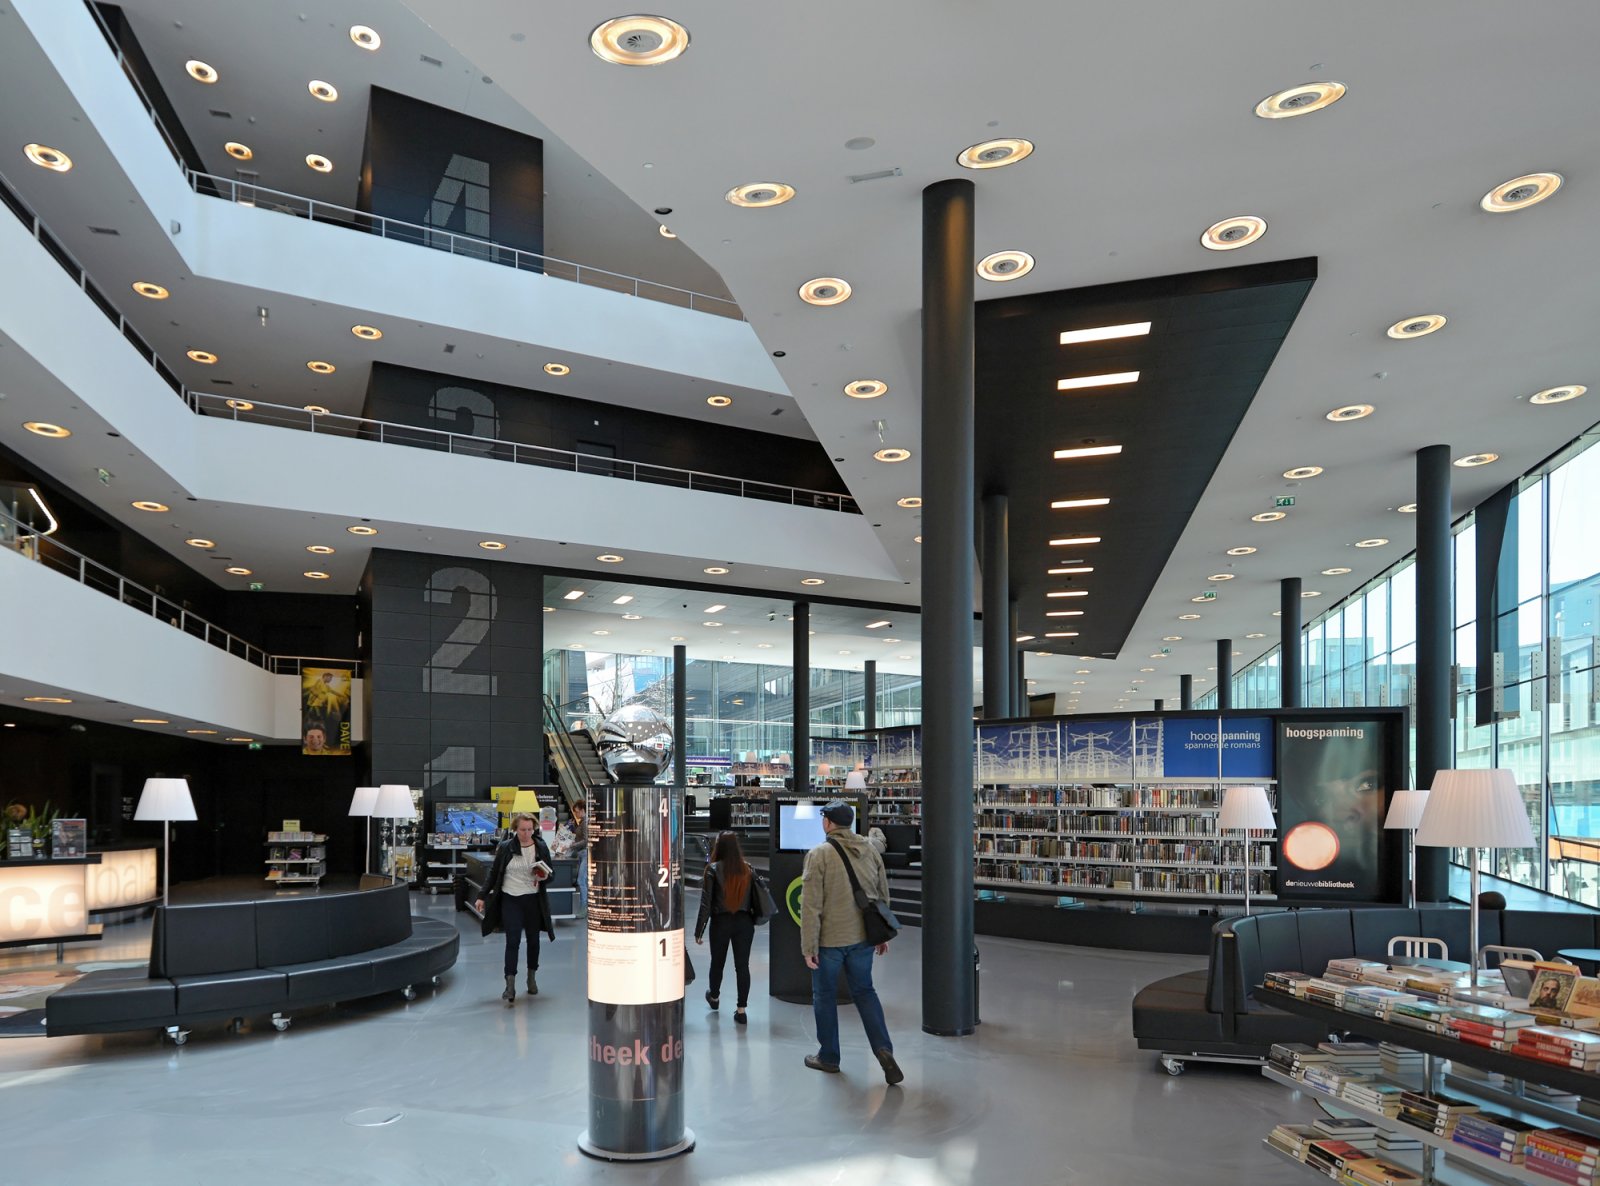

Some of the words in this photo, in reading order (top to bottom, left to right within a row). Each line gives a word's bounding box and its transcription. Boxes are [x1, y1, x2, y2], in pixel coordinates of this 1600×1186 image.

[423, 154, 500, 262] 4
[423, 567, 498, 696] 2
[340, 722, 351, 750] DAVE
[1190, 730, 1261, 743] hoogpanning
[1286, 726, 1364, 740] hoogspanning
[658, 797, 669, 818] 4
[657, 867, 669, 888] 2
[659, 937, 667, 957] 1
[590, 1034, 651, 1066] heek
[661, 1034, 683, 1063] de
